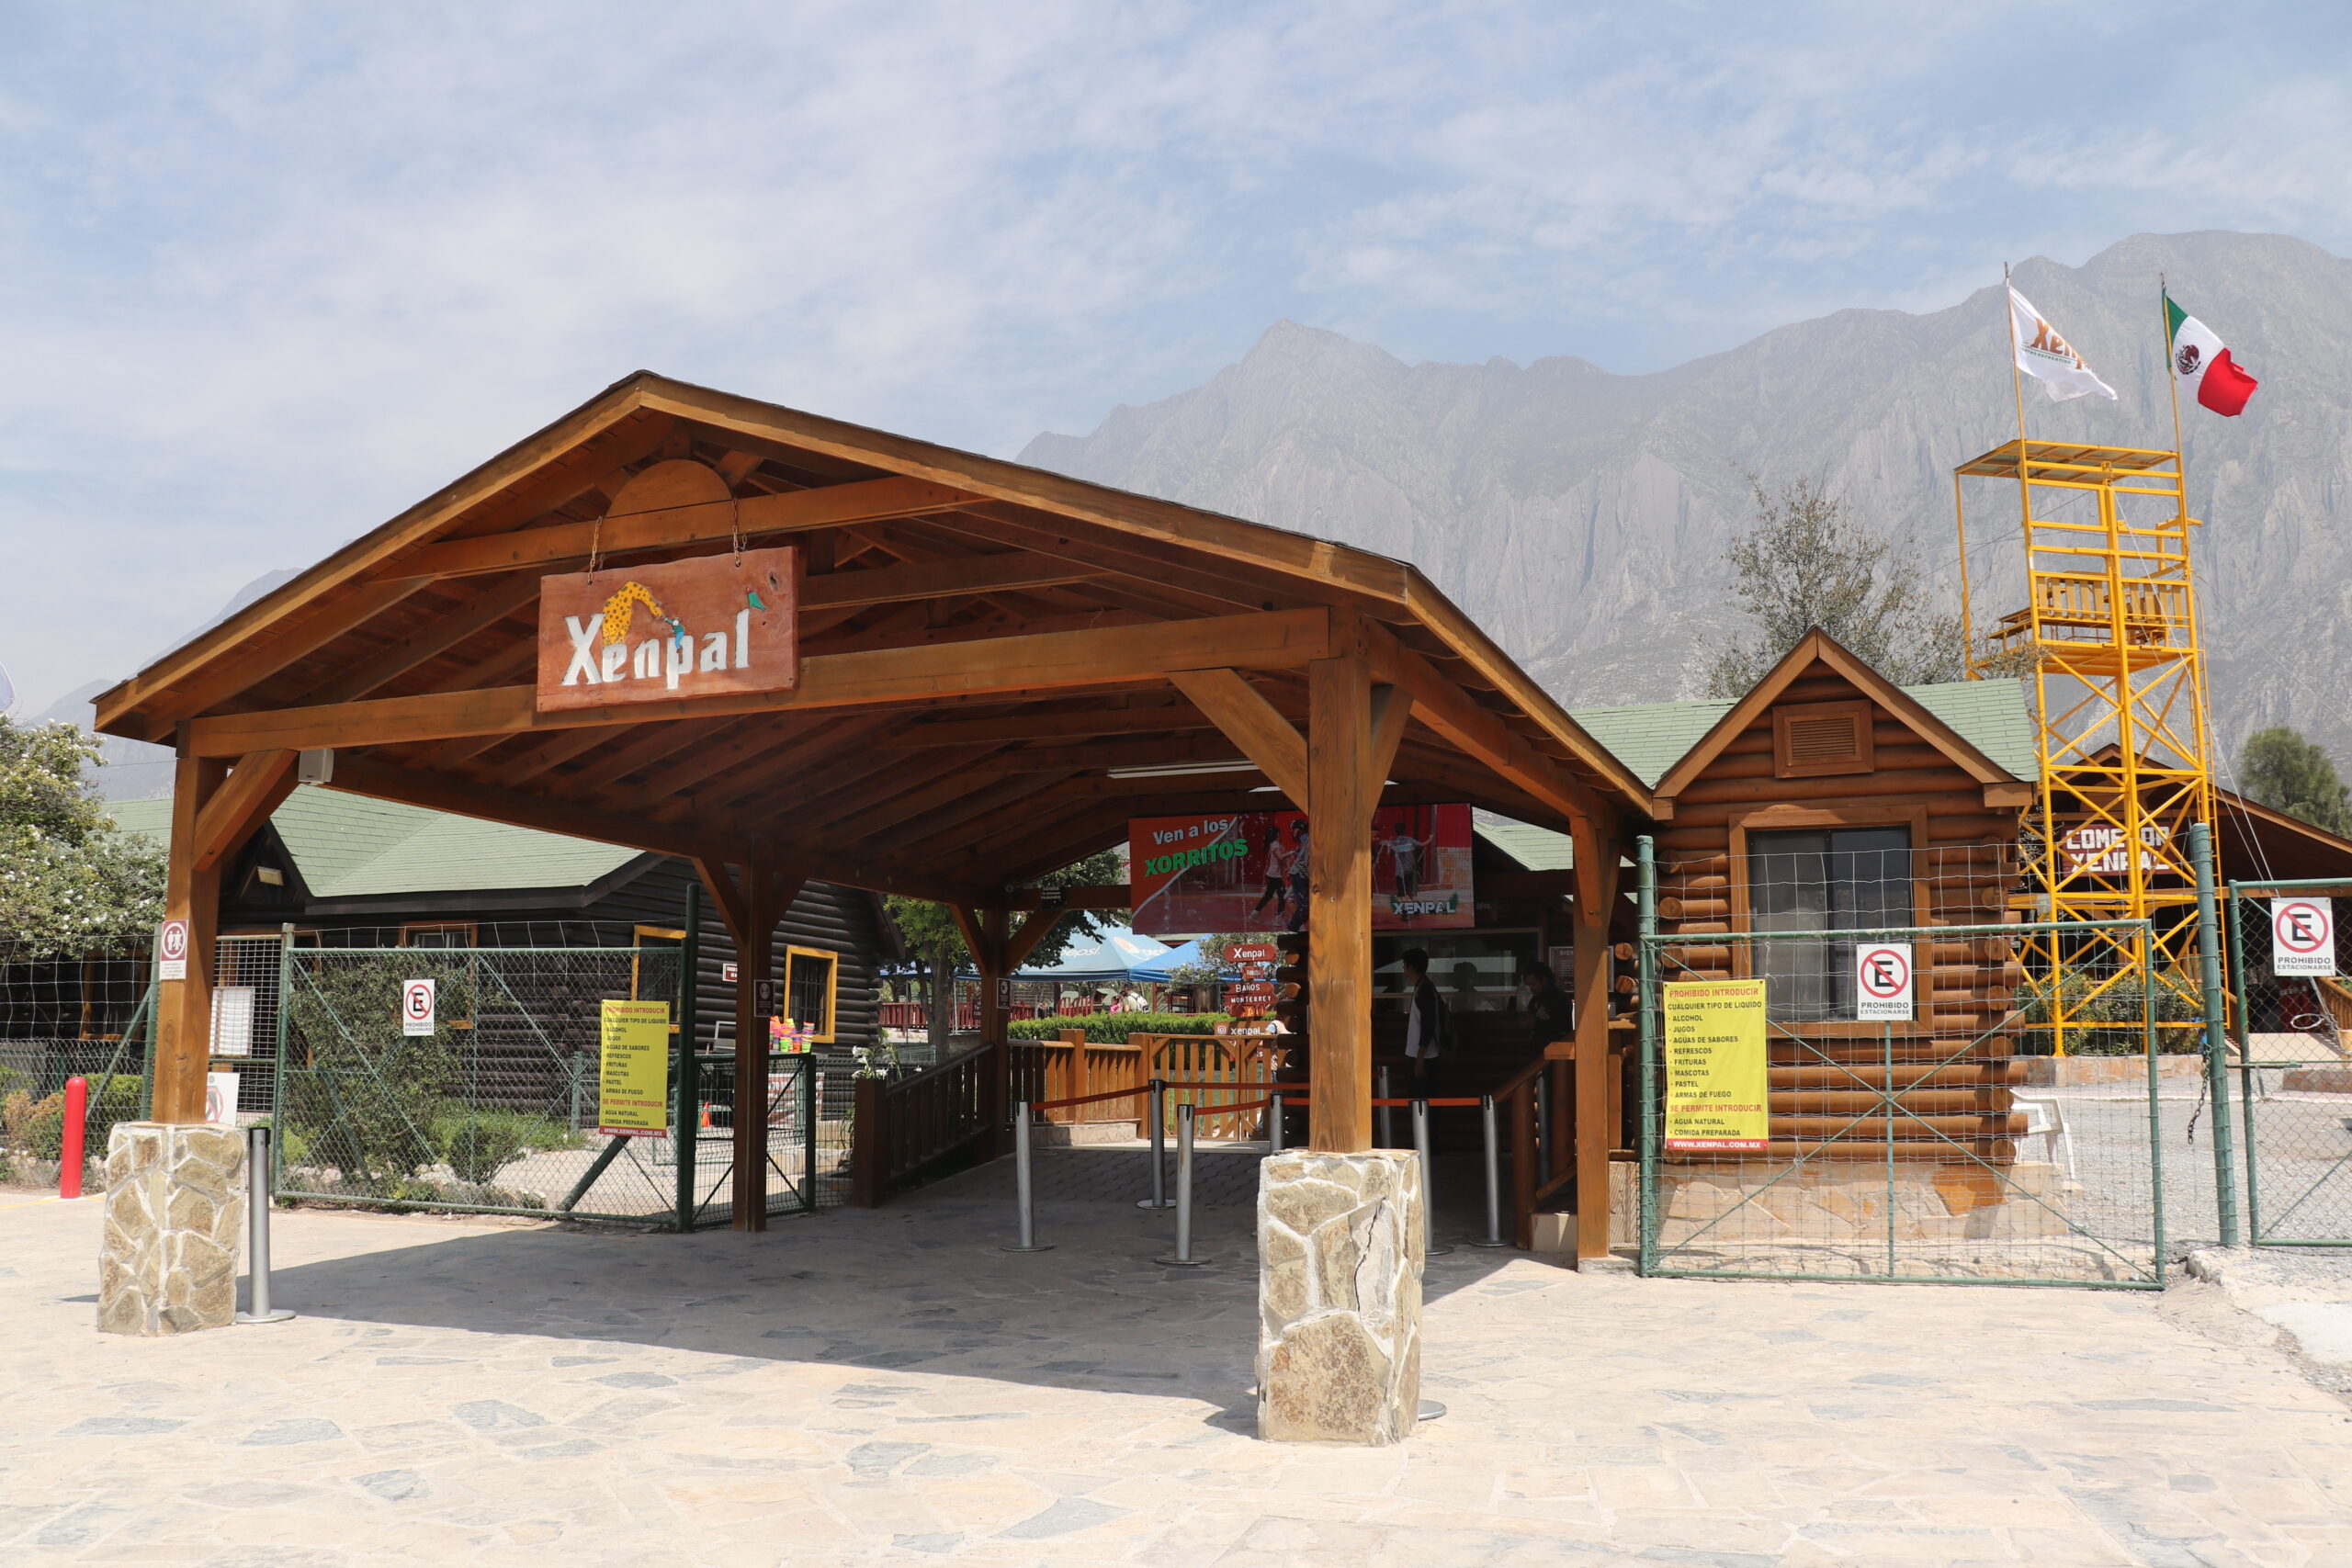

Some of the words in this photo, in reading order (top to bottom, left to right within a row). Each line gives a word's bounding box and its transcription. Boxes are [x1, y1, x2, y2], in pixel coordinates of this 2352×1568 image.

[560, 609, 750, 689] Xenpal
[1153, 829, 1183, 845] Ven
[1189, 826, 1198, 837] a
[1204, 819, 1228, 834] los
[2066, 827, 2170, 849] COMEOR
[1145, 839, 1249, 877] XORRITOS
[1393, 900, 1456, 915] XENPAL
[1233, 948, 1265, 961] Xenpal
[1235, 983, 1261, 993] BAÑOS
[1669, 989, 1710, 998] PROHIBIDO
[1713, 987, 1758, 996] INTRODUCIR
[1668, 1002, 1705, 1010] CUALQUIER
[1681, 1104, 1713, 1112] PERMITE
[1715, 1104, 1762, 1112] INTRODUCIR
